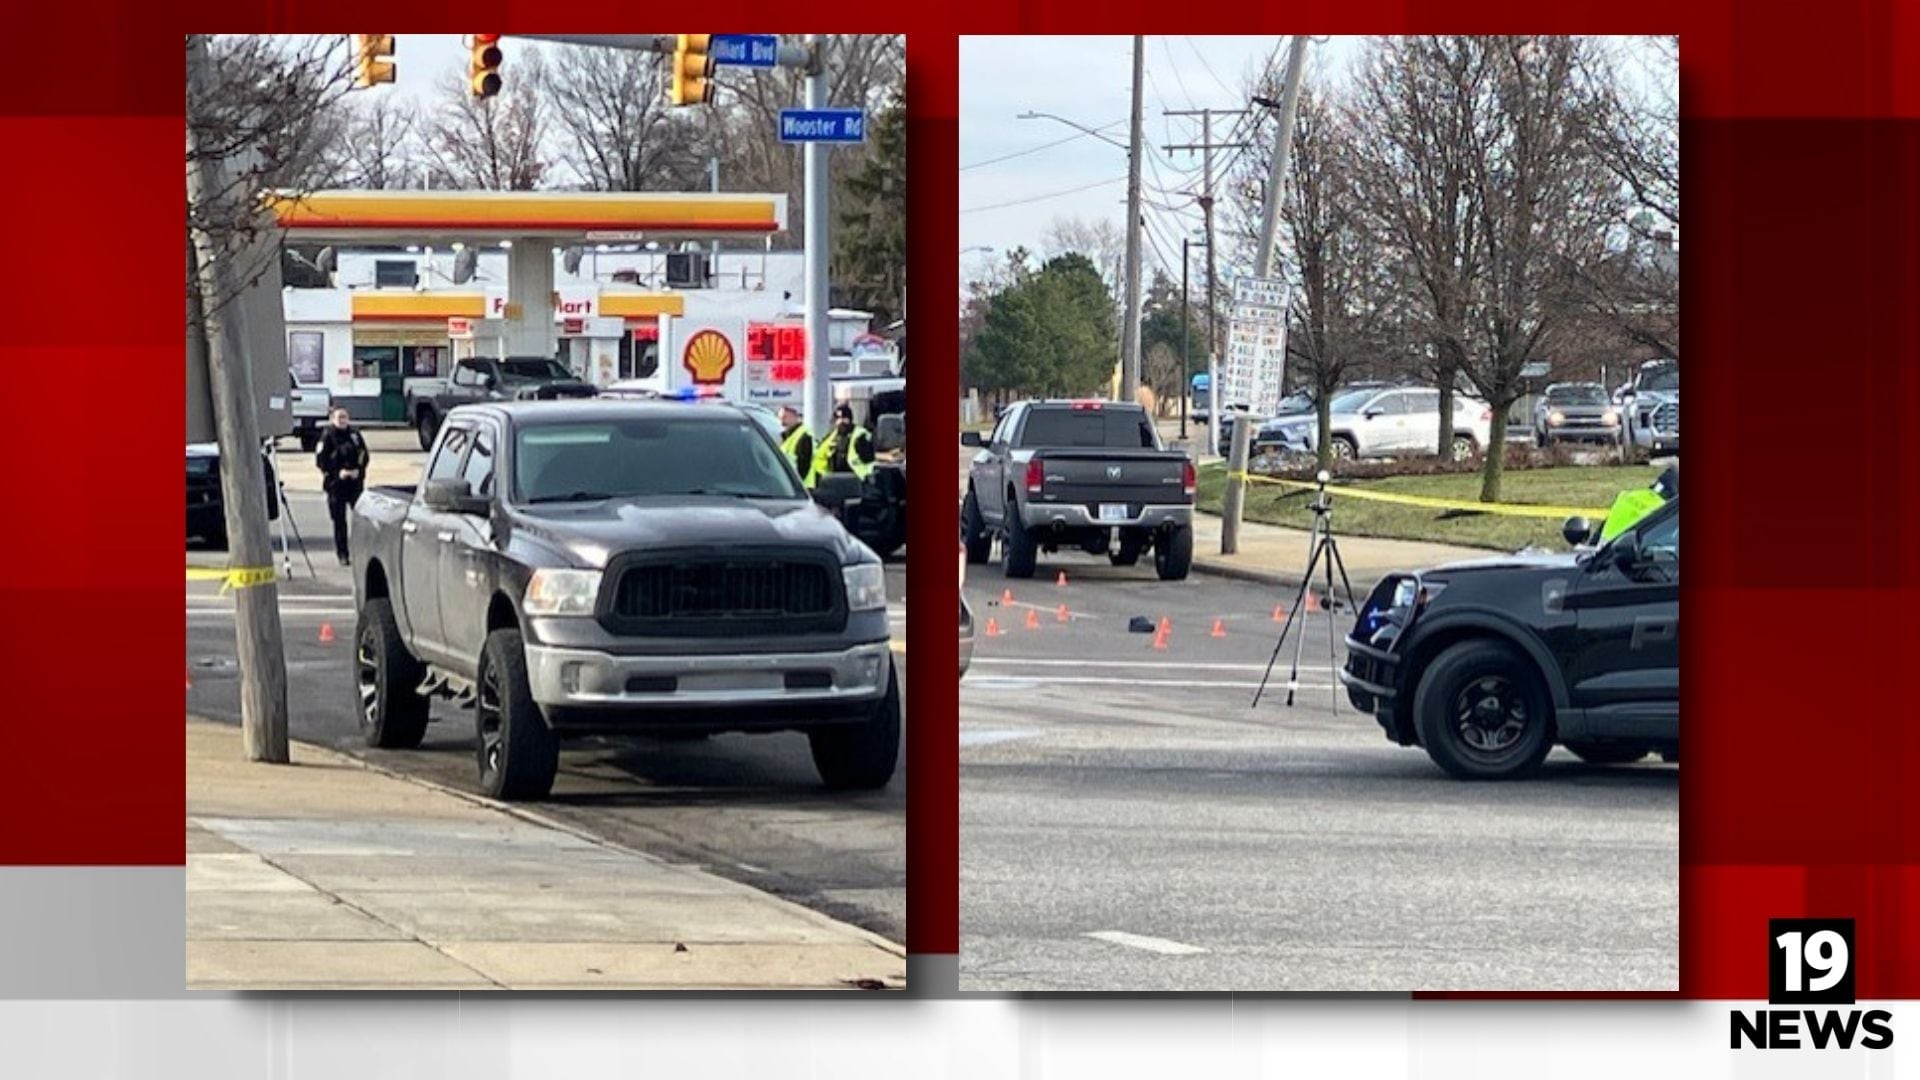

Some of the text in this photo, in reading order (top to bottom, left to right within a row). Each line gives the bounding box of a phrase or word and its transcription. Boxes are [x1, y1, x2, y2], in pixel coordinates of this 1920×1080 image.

[752, 40, 773, 61] Blvd
[783, 115, 861, 136] Wooster Rd
